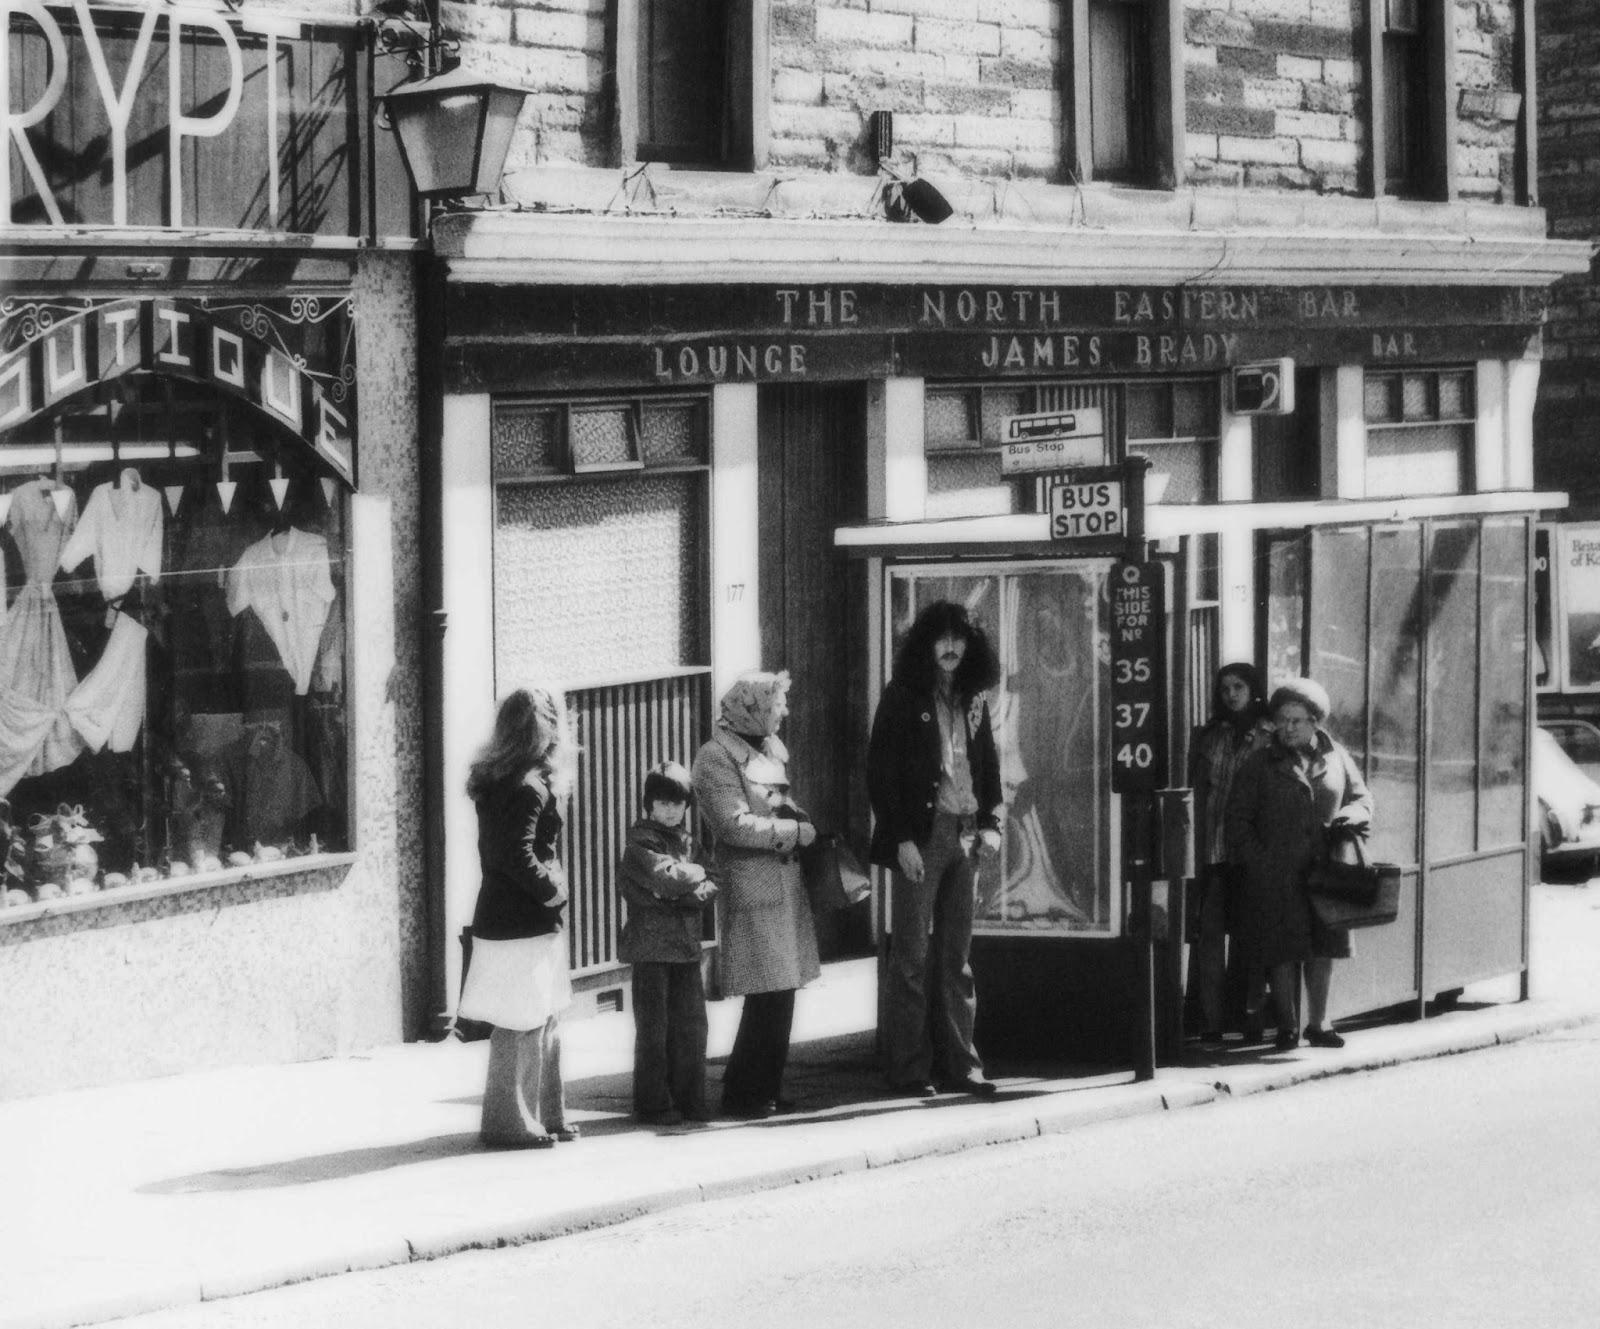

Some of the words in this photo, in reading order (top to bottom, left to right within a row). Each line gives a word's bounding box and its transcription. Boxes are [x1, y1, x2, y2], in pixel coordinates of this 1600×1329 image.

[776, 289, 858, 324] THE
[920, 290, 1061, 327] NORTH
[1114, 290, 1260, 323] EASTERN
[1303, 290, 1359, 319] BAR
[981, 335, 1101, 367] JAMES
[1136, 334, 1239, 366] BRADY
[1372, 333, 1417, 358] BAR
[655, 344, 807, 379] LOUNGE
[1009, 445, 1031, 455] Bus
[1036, 442, 1065, 453] Stop
[1062, 485, 1110, 509] BUS
[1055, 511, 1118, 536] STOP
[1122, 565, 1141, 584] Q
[726, 583, 745, 602] 177
[1115, 586, 1151, 601] THIS
[1114, 601, 1151, 615] SIDE
[1116, 614, 1148, 627] FOR
[1115, 658, 1151, 684] 35
[1115, 702, 1151, 728] 37
[1116, 743, 1153, 768] 40
